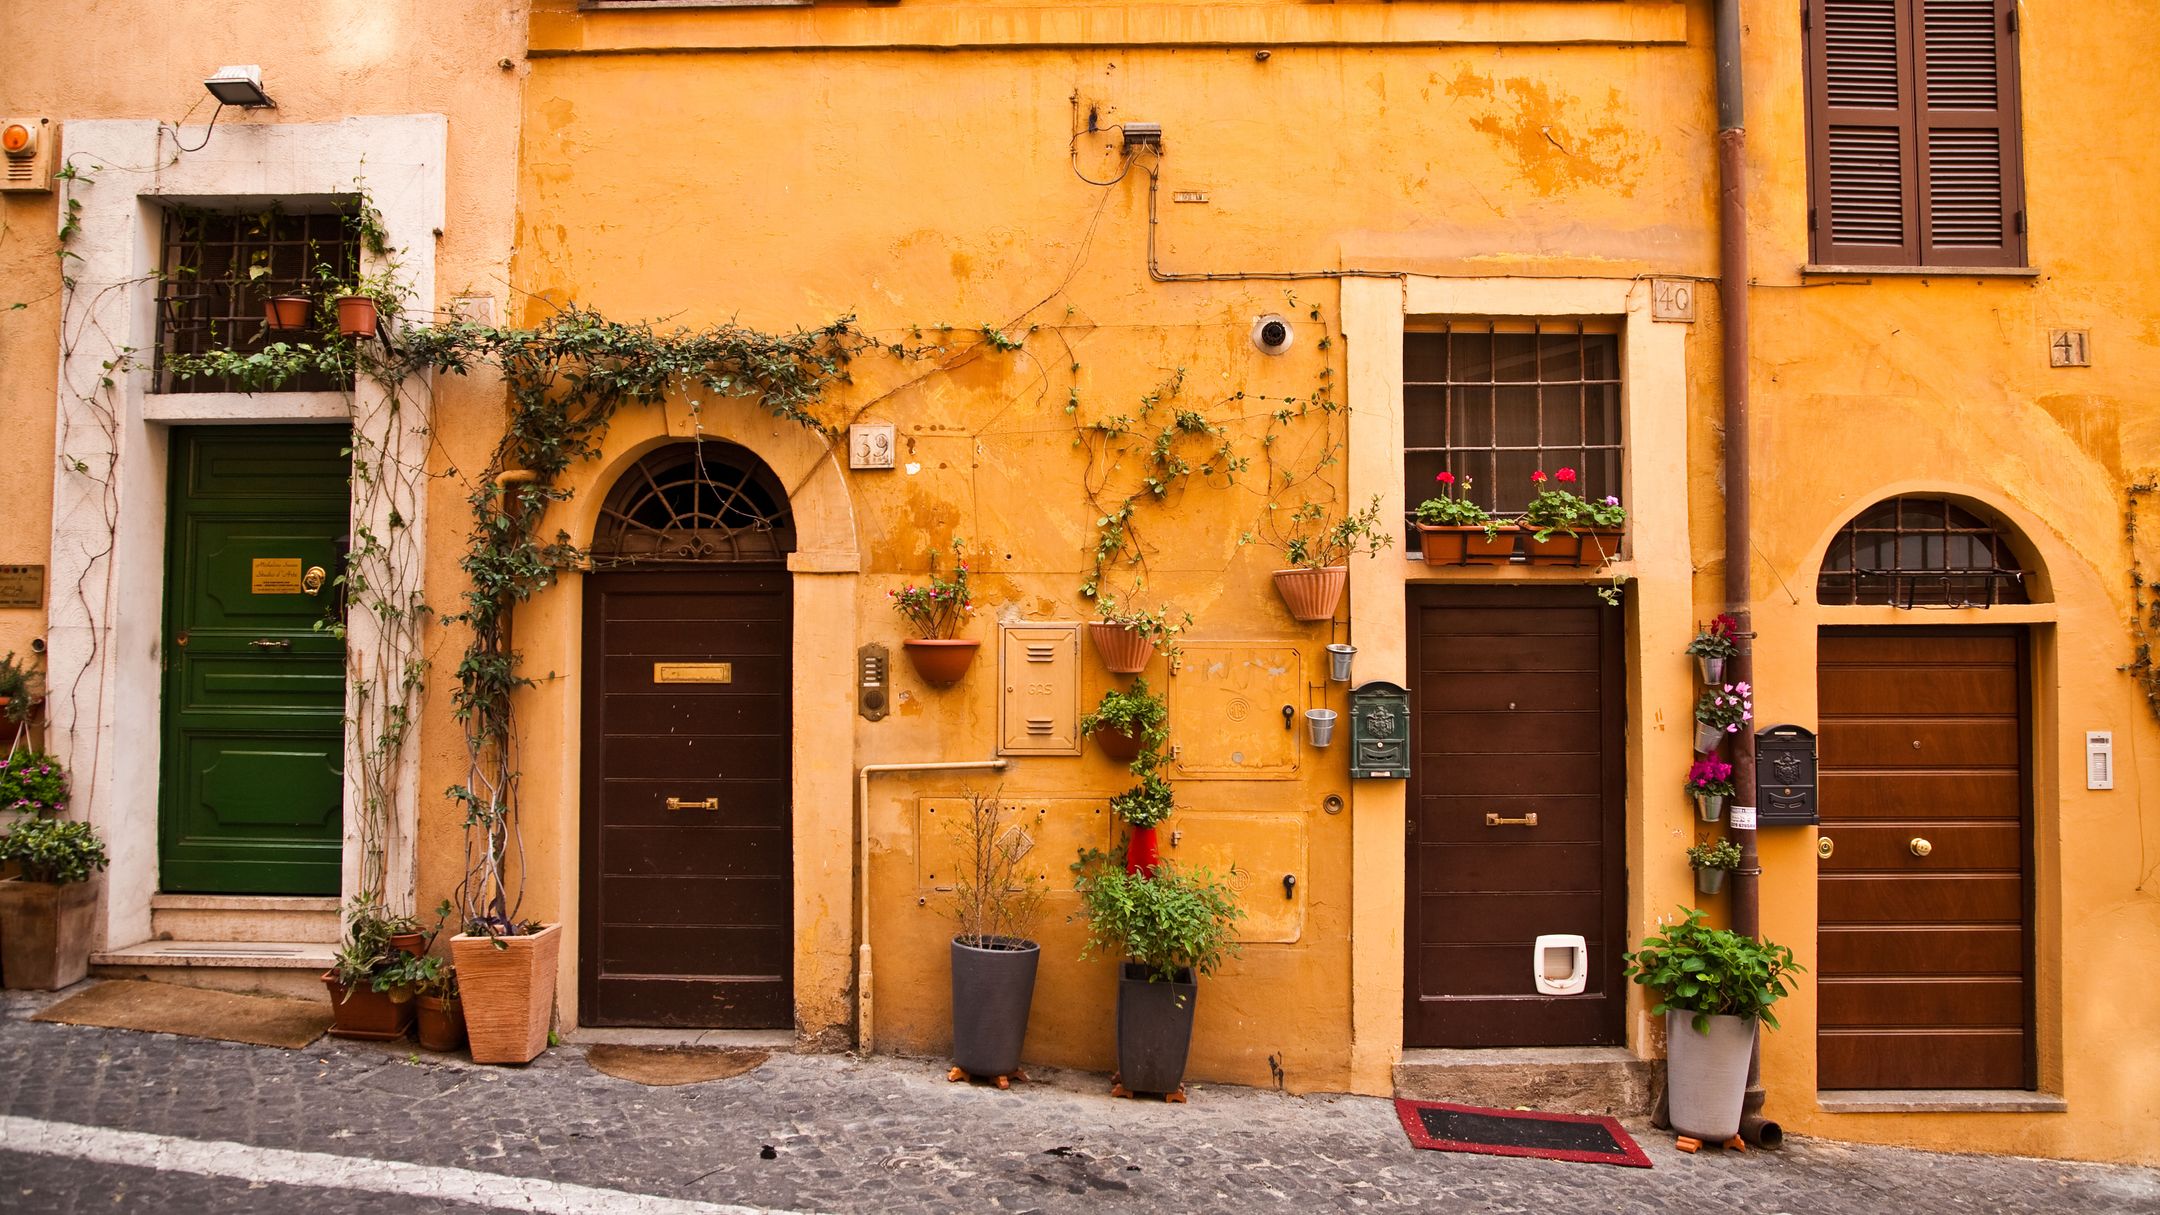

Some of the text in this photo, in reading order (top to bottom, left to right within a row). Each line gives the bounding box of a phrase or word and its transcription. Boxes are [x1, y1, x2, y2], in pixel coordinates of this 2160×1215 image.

[1658, 286, 1689, 311] 40
[2052, 331, 2086, 363] 41
[857, 433, 888, 458] 39
[1028, 683, 1053, 696] GAS
